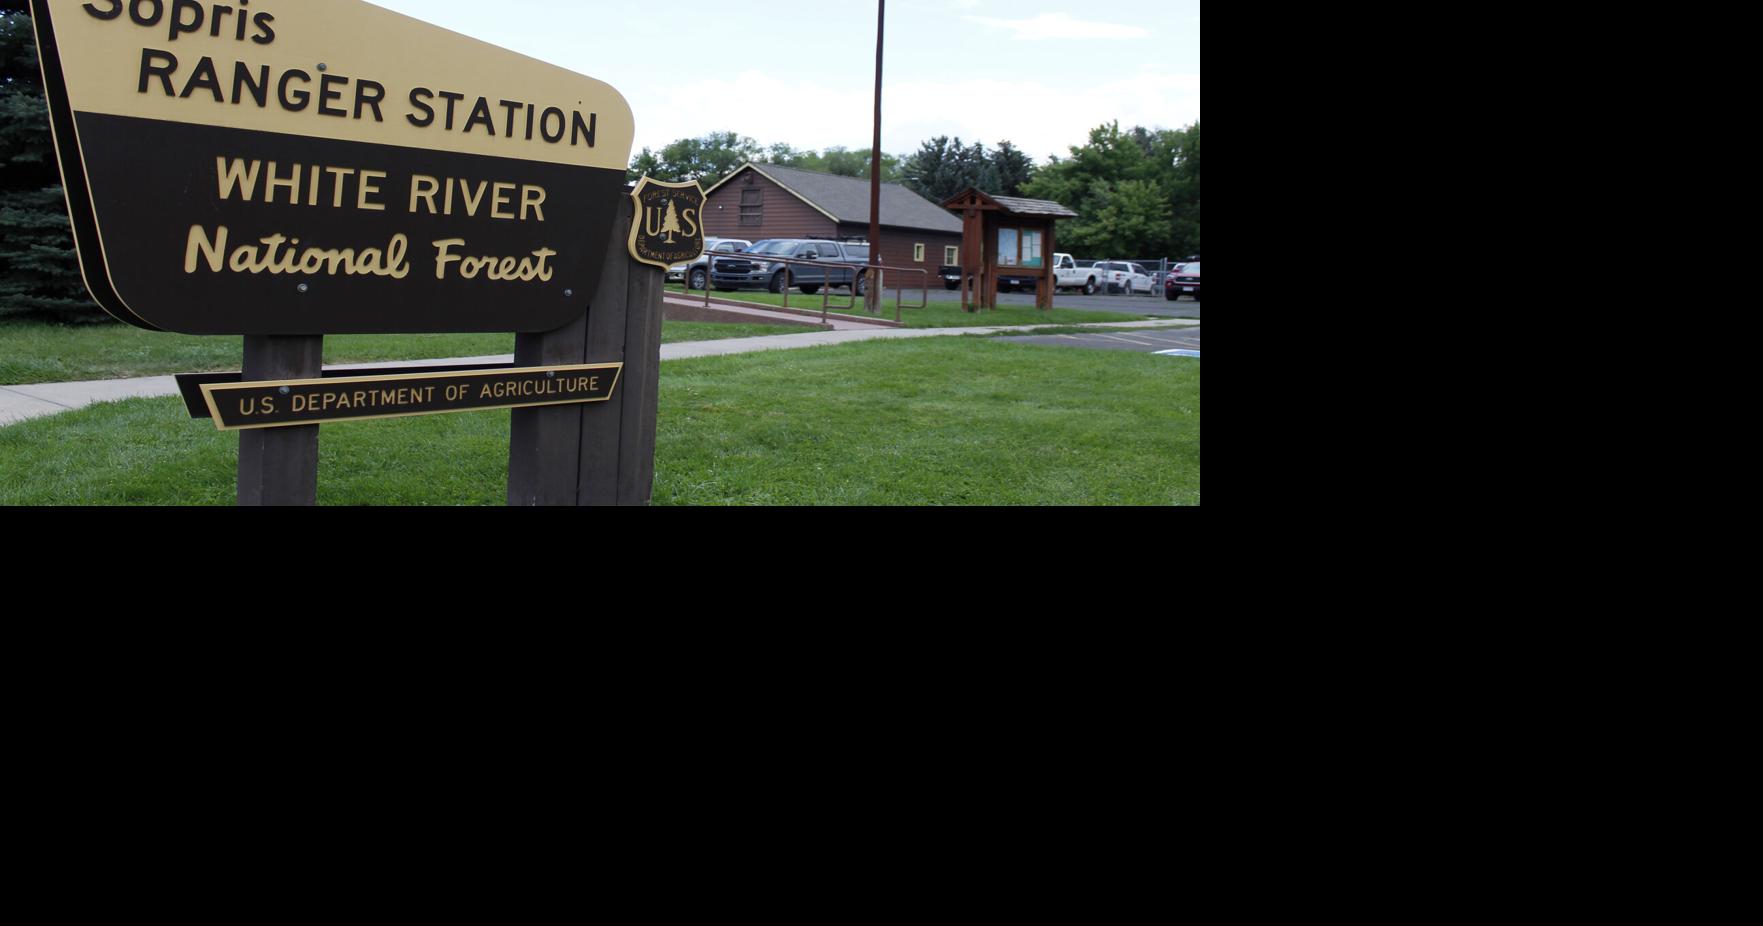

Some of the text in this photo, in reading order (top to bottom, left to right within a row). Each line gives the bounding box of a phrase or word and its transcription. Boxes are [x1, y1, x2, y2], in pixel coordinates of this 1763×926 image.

[137, 48, 597, 148] RANGER STATION
[216, 156, 546, 221] WHITE RIVER
[184, 224, 557, 282] National Forest
[239, 376, 599, 415] U.S. DEPARTMENT OF AGRICULTURE
